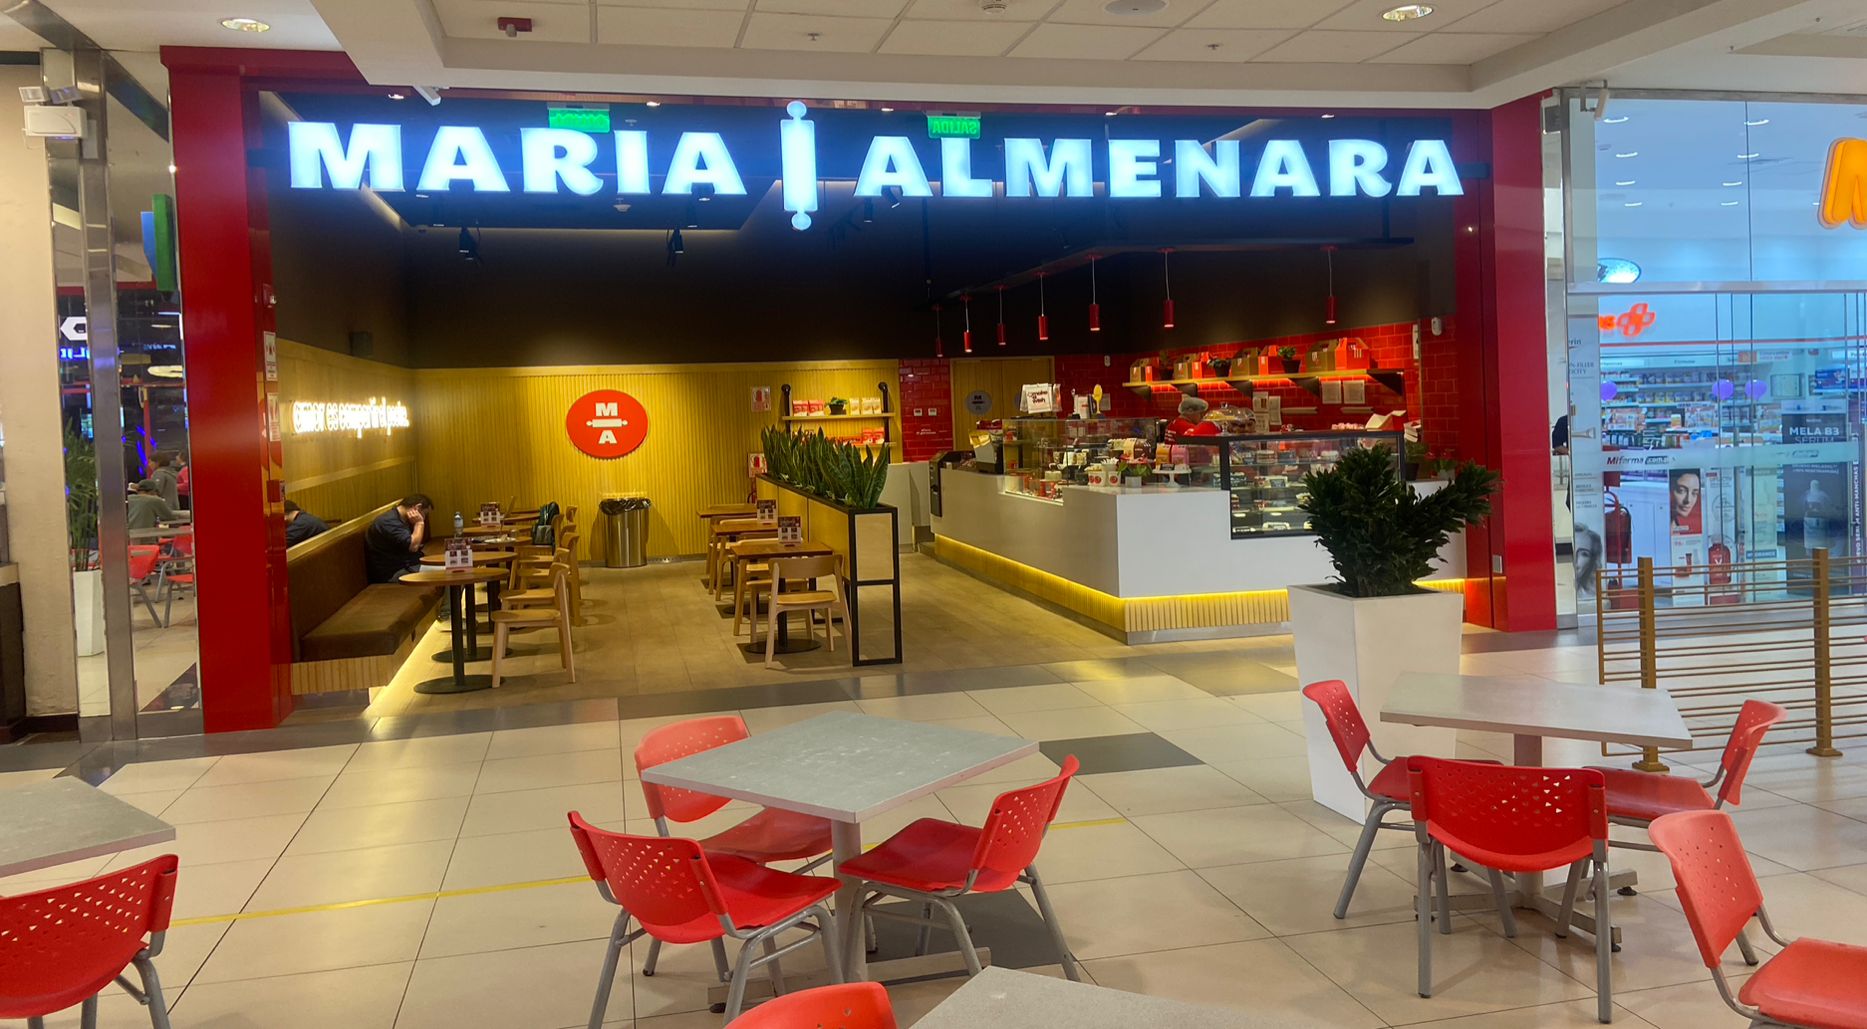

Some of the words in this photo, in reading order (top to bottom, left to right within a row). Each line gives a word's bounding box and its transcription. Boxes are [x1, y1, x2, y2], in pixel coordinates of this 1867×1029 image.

[288, 121, 747, 196] MARIA
[853, 136, 1465, 197] ALMENARA
[595, 402, 618, 417] M
[598, 429, 617, 444] A
[1789, 426, 1821, 436] MELA
[1824, 426, 1840, 436] B3
